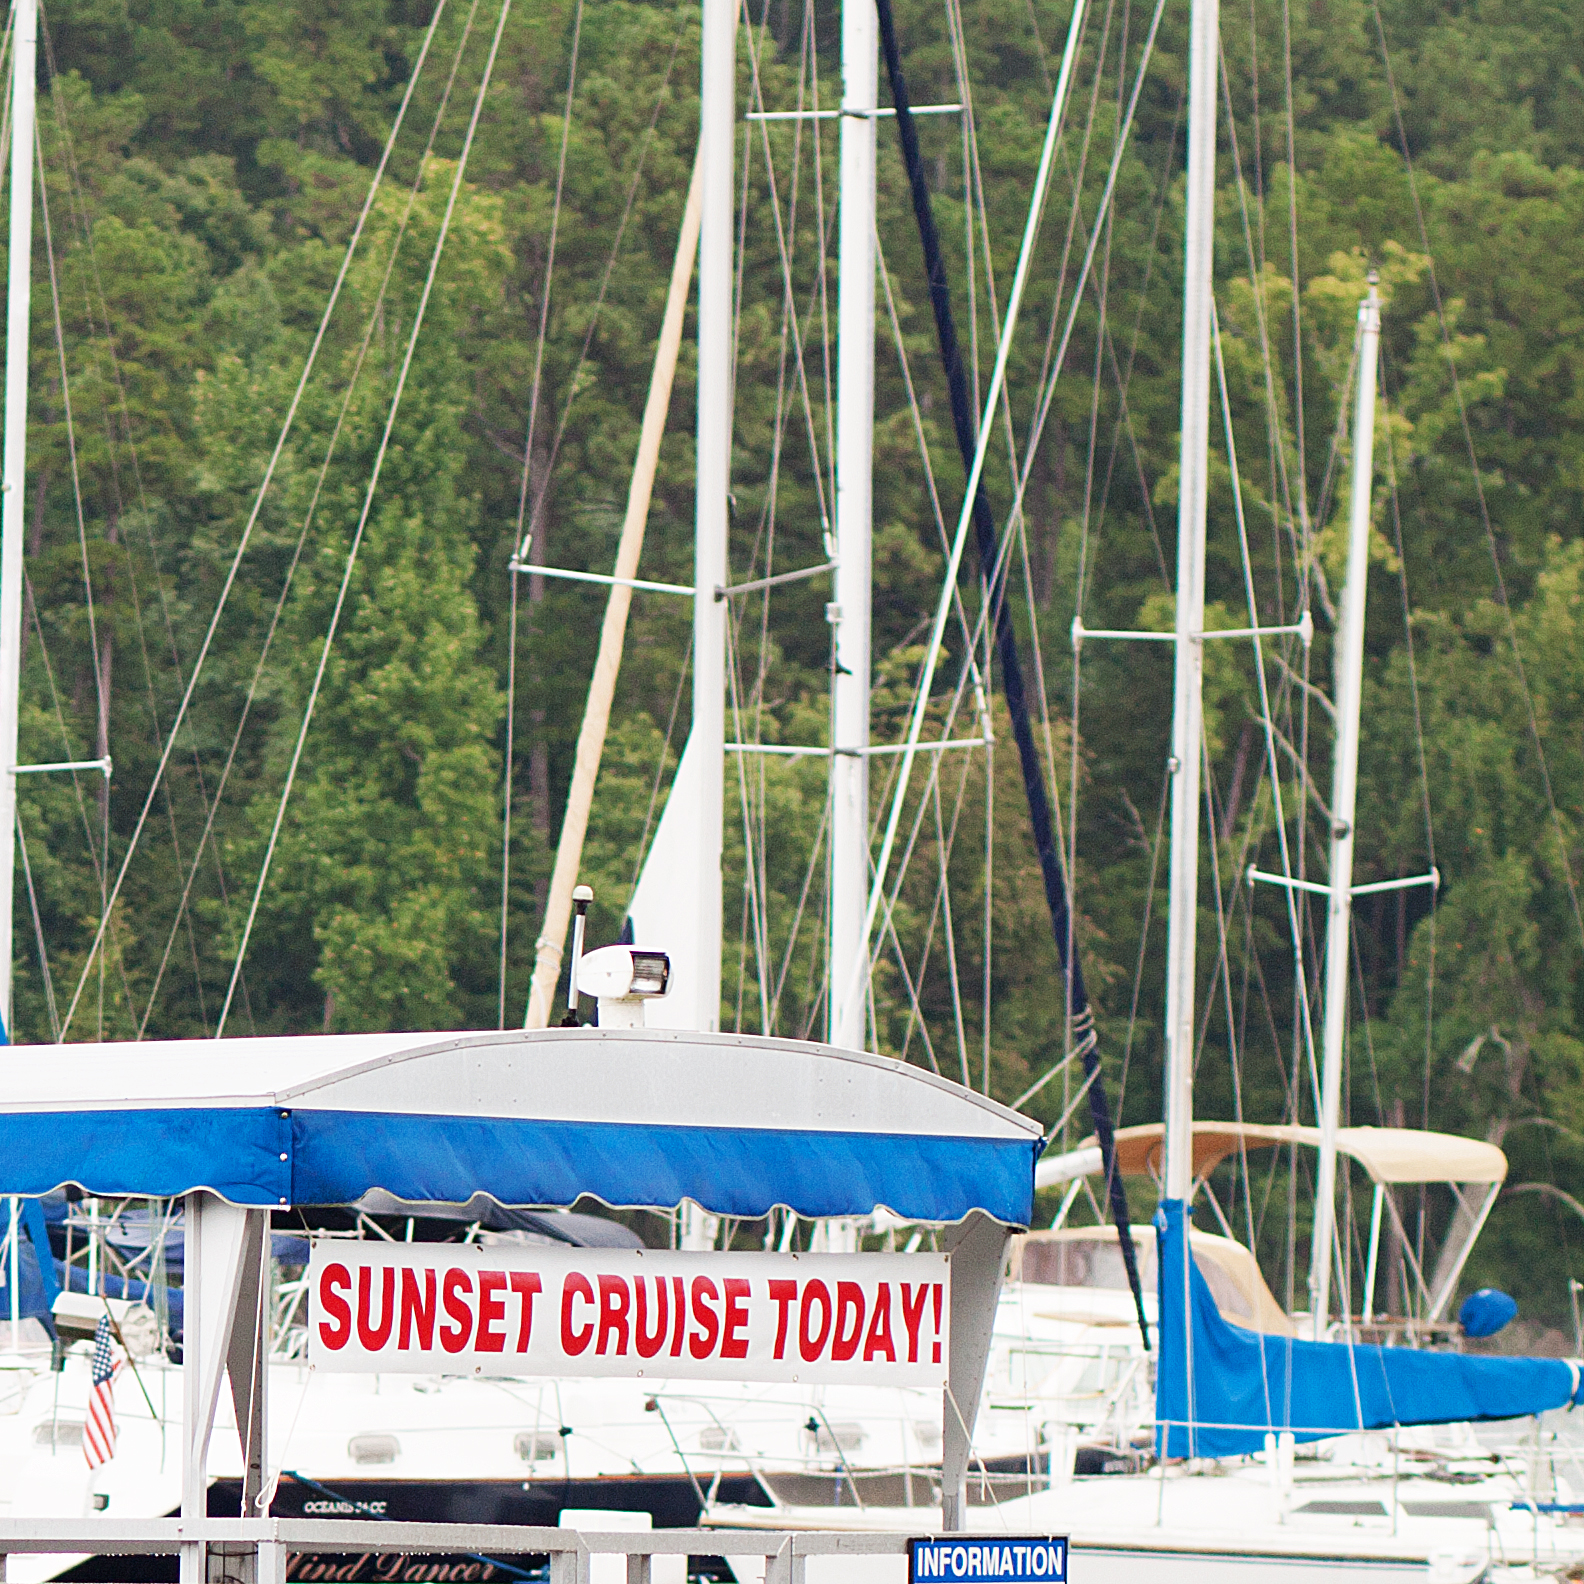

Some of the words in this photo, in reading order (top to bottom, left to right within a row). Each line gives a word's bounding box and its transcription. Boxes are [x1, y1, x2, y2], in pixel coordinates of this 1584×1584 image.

[318, 1262, 543, 1354] SUNSET
[560, 1271, 752, 1360] CRUISE
[767, 1278, 943, 1364] TODAY!
[370, 1501, 387, 1513] CC
[374, 1552, 497, 1581] Dancer
[917, 1546, 1062, 1577] INFORMATION
